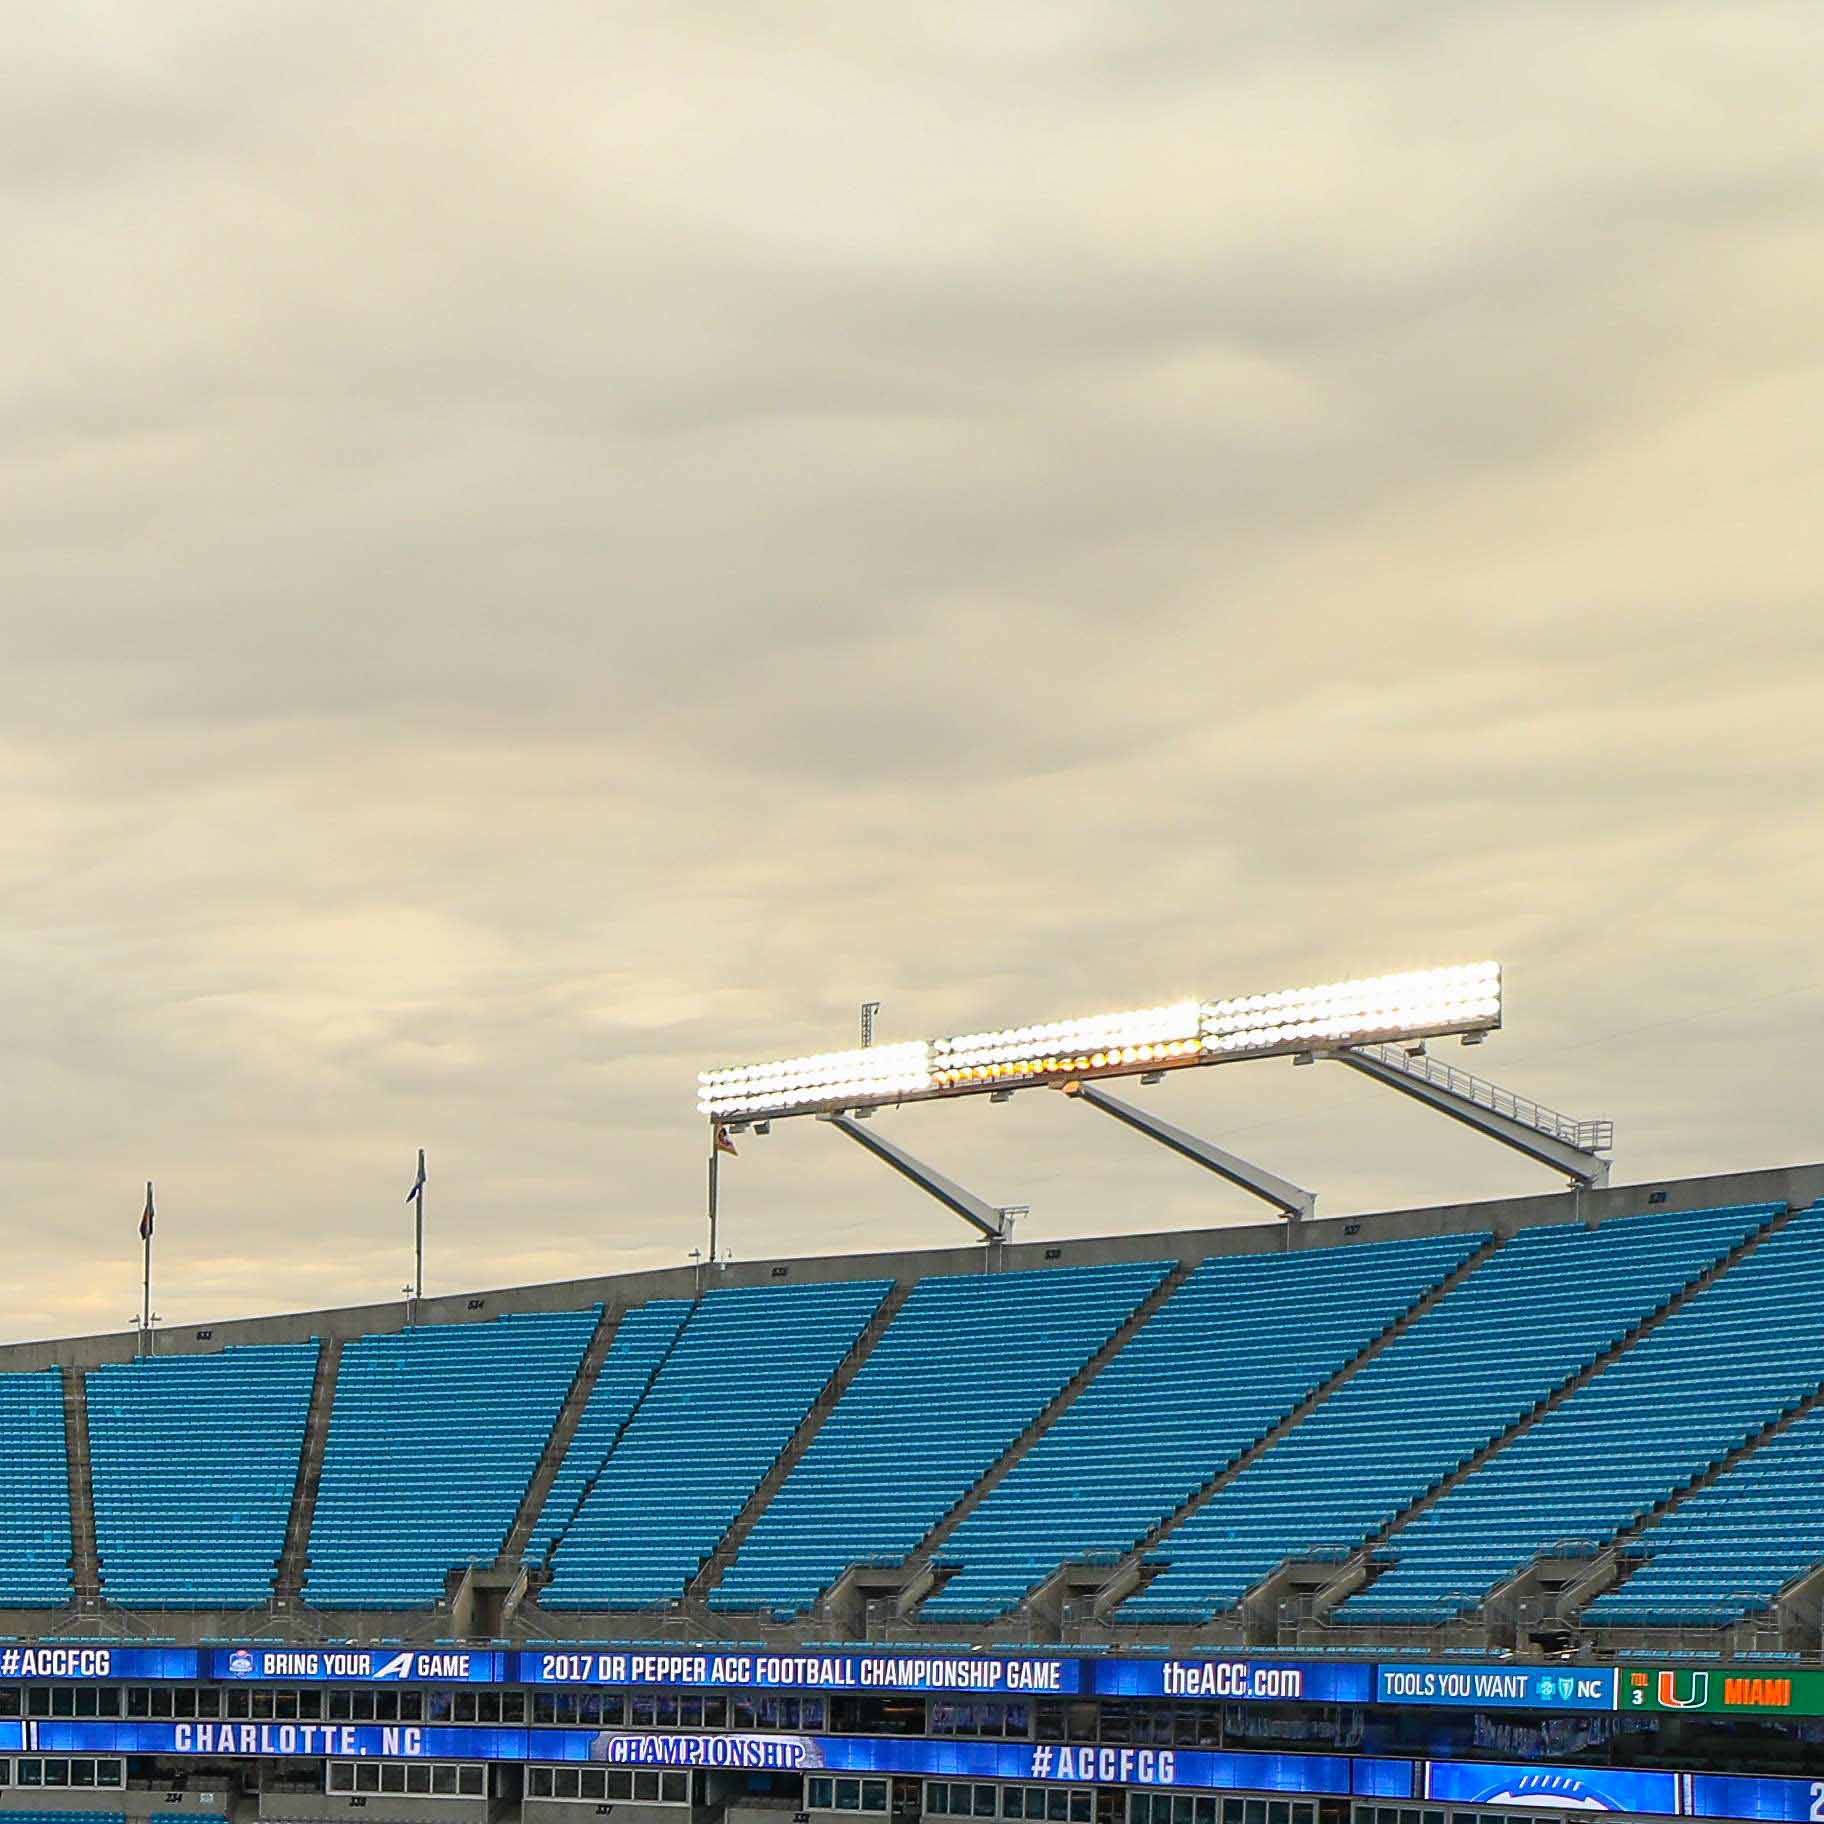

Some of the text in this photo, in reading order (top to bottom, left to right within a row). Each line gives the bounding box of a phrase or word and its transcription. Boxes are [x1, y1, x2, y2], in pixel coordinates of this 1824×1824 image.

[1, 1649, 111, 1676] #ACCFCG
[264, 1652, 470, 1679] BRING YOUR A GAME
[542, 1655, 1060, 1690] 2017 DR PEPPER ACC FOOTBALL CHAMPIONSHIP GAME
[1162, 1662, 1301, 1697] theACC.com
[1384, 1673, 1528, 1698] TOOLS YOU WANT
[1578, 1681, 1602, 1699] NC
[1724, 1678, 1792, 1706] MIAMI
[1632, 1689, 1644, 1705] 3
[175, 1724, 422, 1756] CHARLOTTE, NC
[607, 1737, 807, 1769] CHAMPIONSHIP
[1032, 1746, 1175, 1784] #ACCFCG
